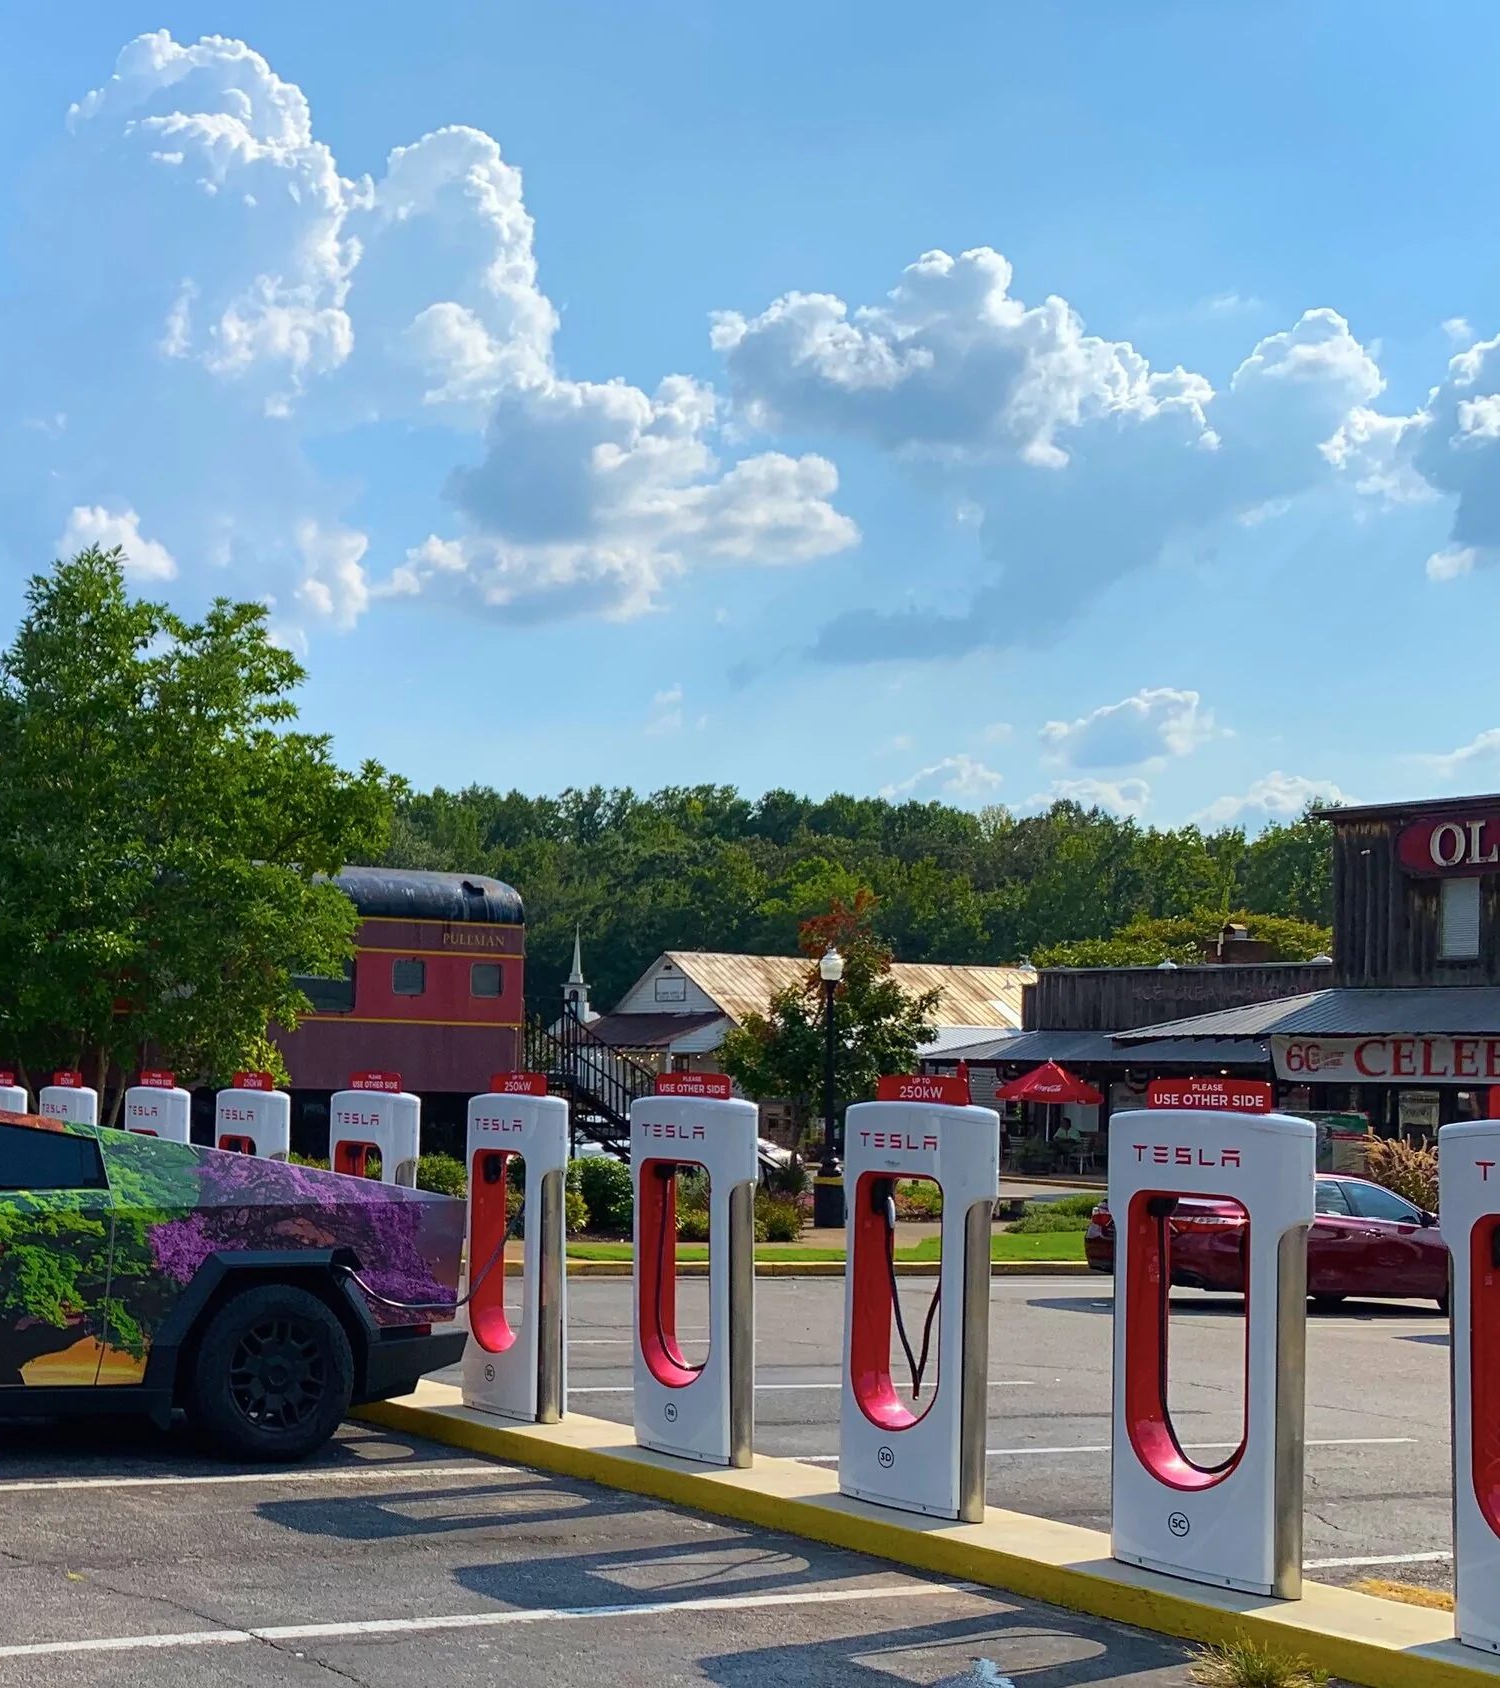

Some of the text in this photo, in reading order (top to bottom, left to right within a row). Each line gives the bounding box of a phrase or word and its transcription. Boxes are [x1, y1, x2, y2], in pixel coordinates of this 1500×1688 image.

[1429, 820, 1499, 867] OL
[443, 932, 505, 947] PULLMAN
[352, 1080, 398, 1090] USE OTHER SIDE
[682, 1075, 702, 1083] PLEASE
[912, 1077, 931, 1085] UP TO
[504, 1081, 532, 1092] 250kW
[659, 1083, 726, 1095] USE OTHER SIDE
[899, 1085, 943, 1099] 250kW
[1191, 1083, 1224, 1092] PLEASE
[1153, 1093, 1264, 1107] USE OTHER SIDE
[128, 1105, 158, 1117] TESLA
[220, 1108, 254, 1121] TESLA
[337, 1112, 380, 1126] TESLA
[475, 1118, 523, 1132] TESLA
[642, 1123, 705, 1140] TESLA
[860, 1132, 938, 1151] TESLA
[1132, 1144, 1241, 1168] TESLA
[880, 1451, 892, 1462] 3D
[1172, 1518, 1186, 1530] 5C
